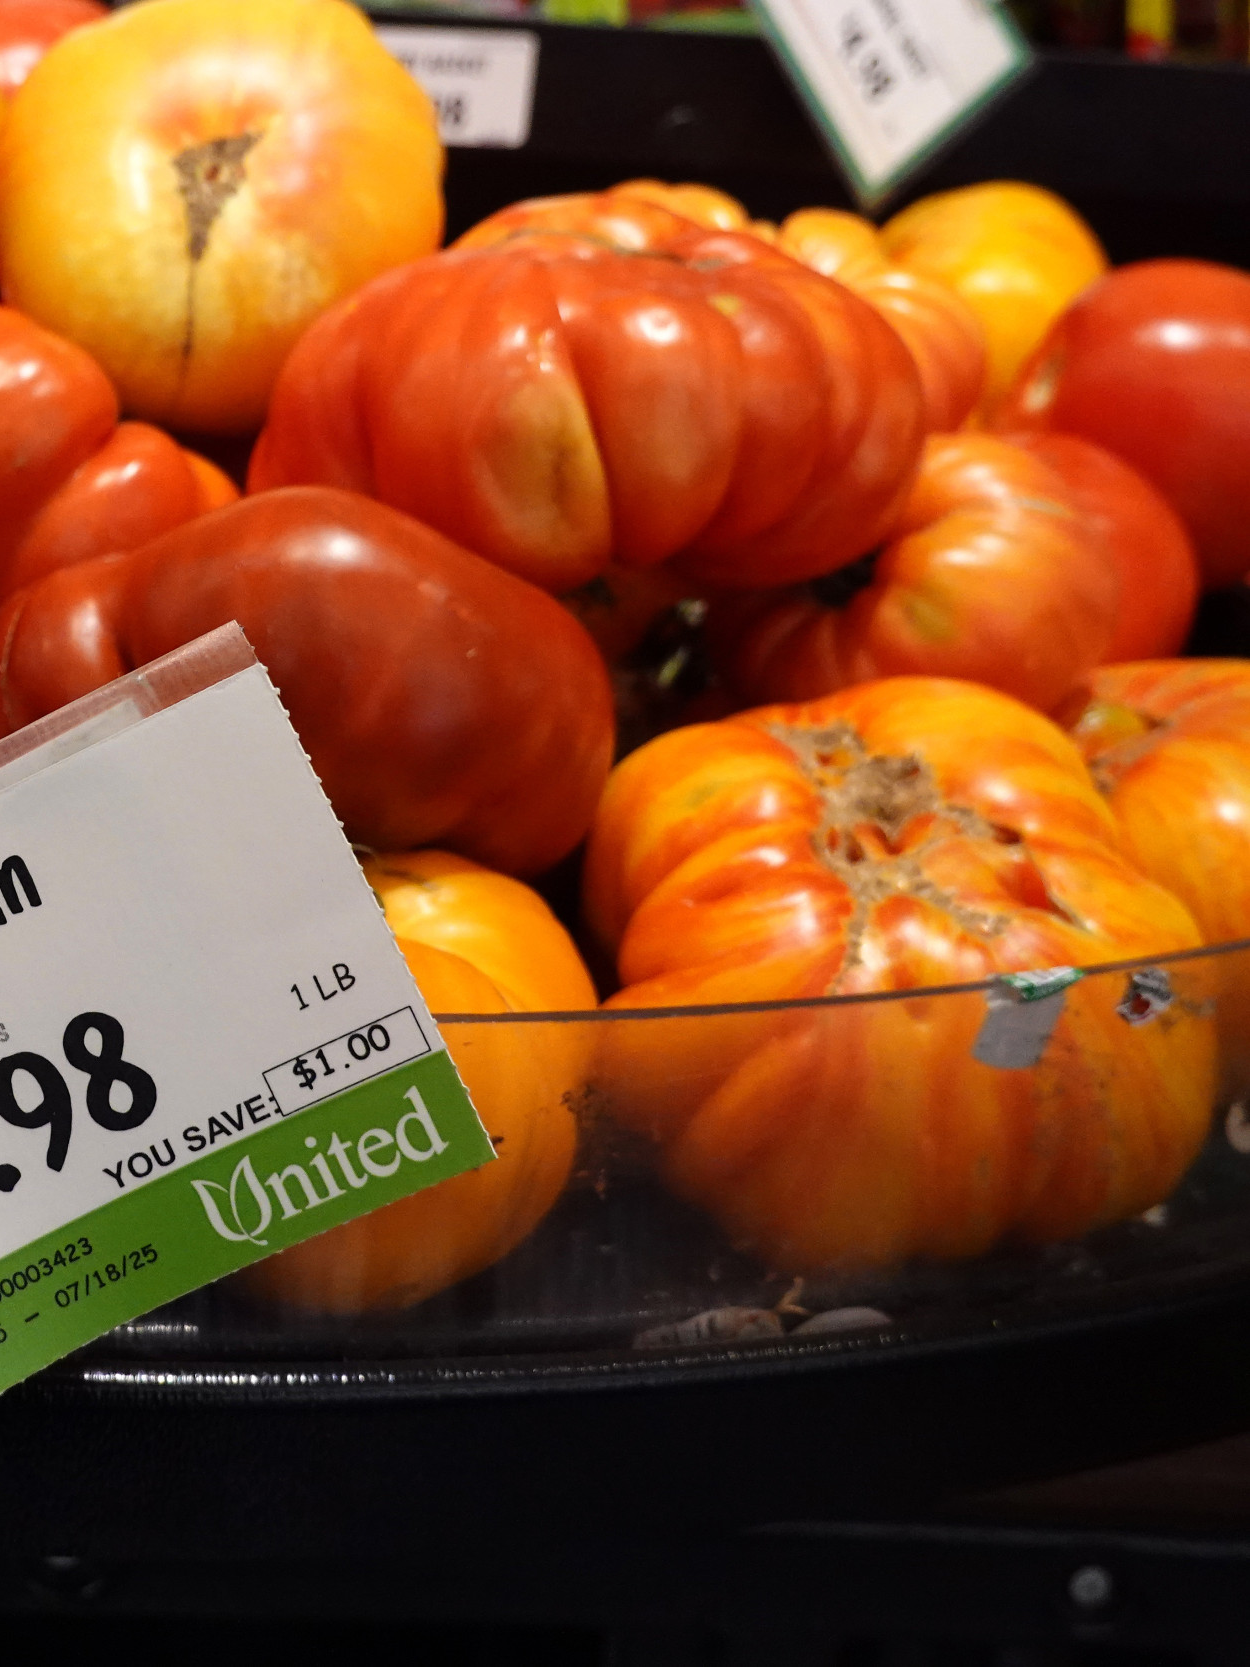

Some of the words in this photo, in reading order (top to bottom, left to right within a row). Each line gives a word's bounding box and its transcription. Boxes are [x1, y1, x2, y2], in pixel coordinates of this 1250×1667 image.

[290, 983, 310, 1012] 1
[312, 962, 357, 1002] LB
[292, 1023, 391, 1091] $1.00
[102, 1138, 177, 1190] YOU
[190, 1085, 450, 1246] United
[54, 1243, 159, 1309] 07/18/25
